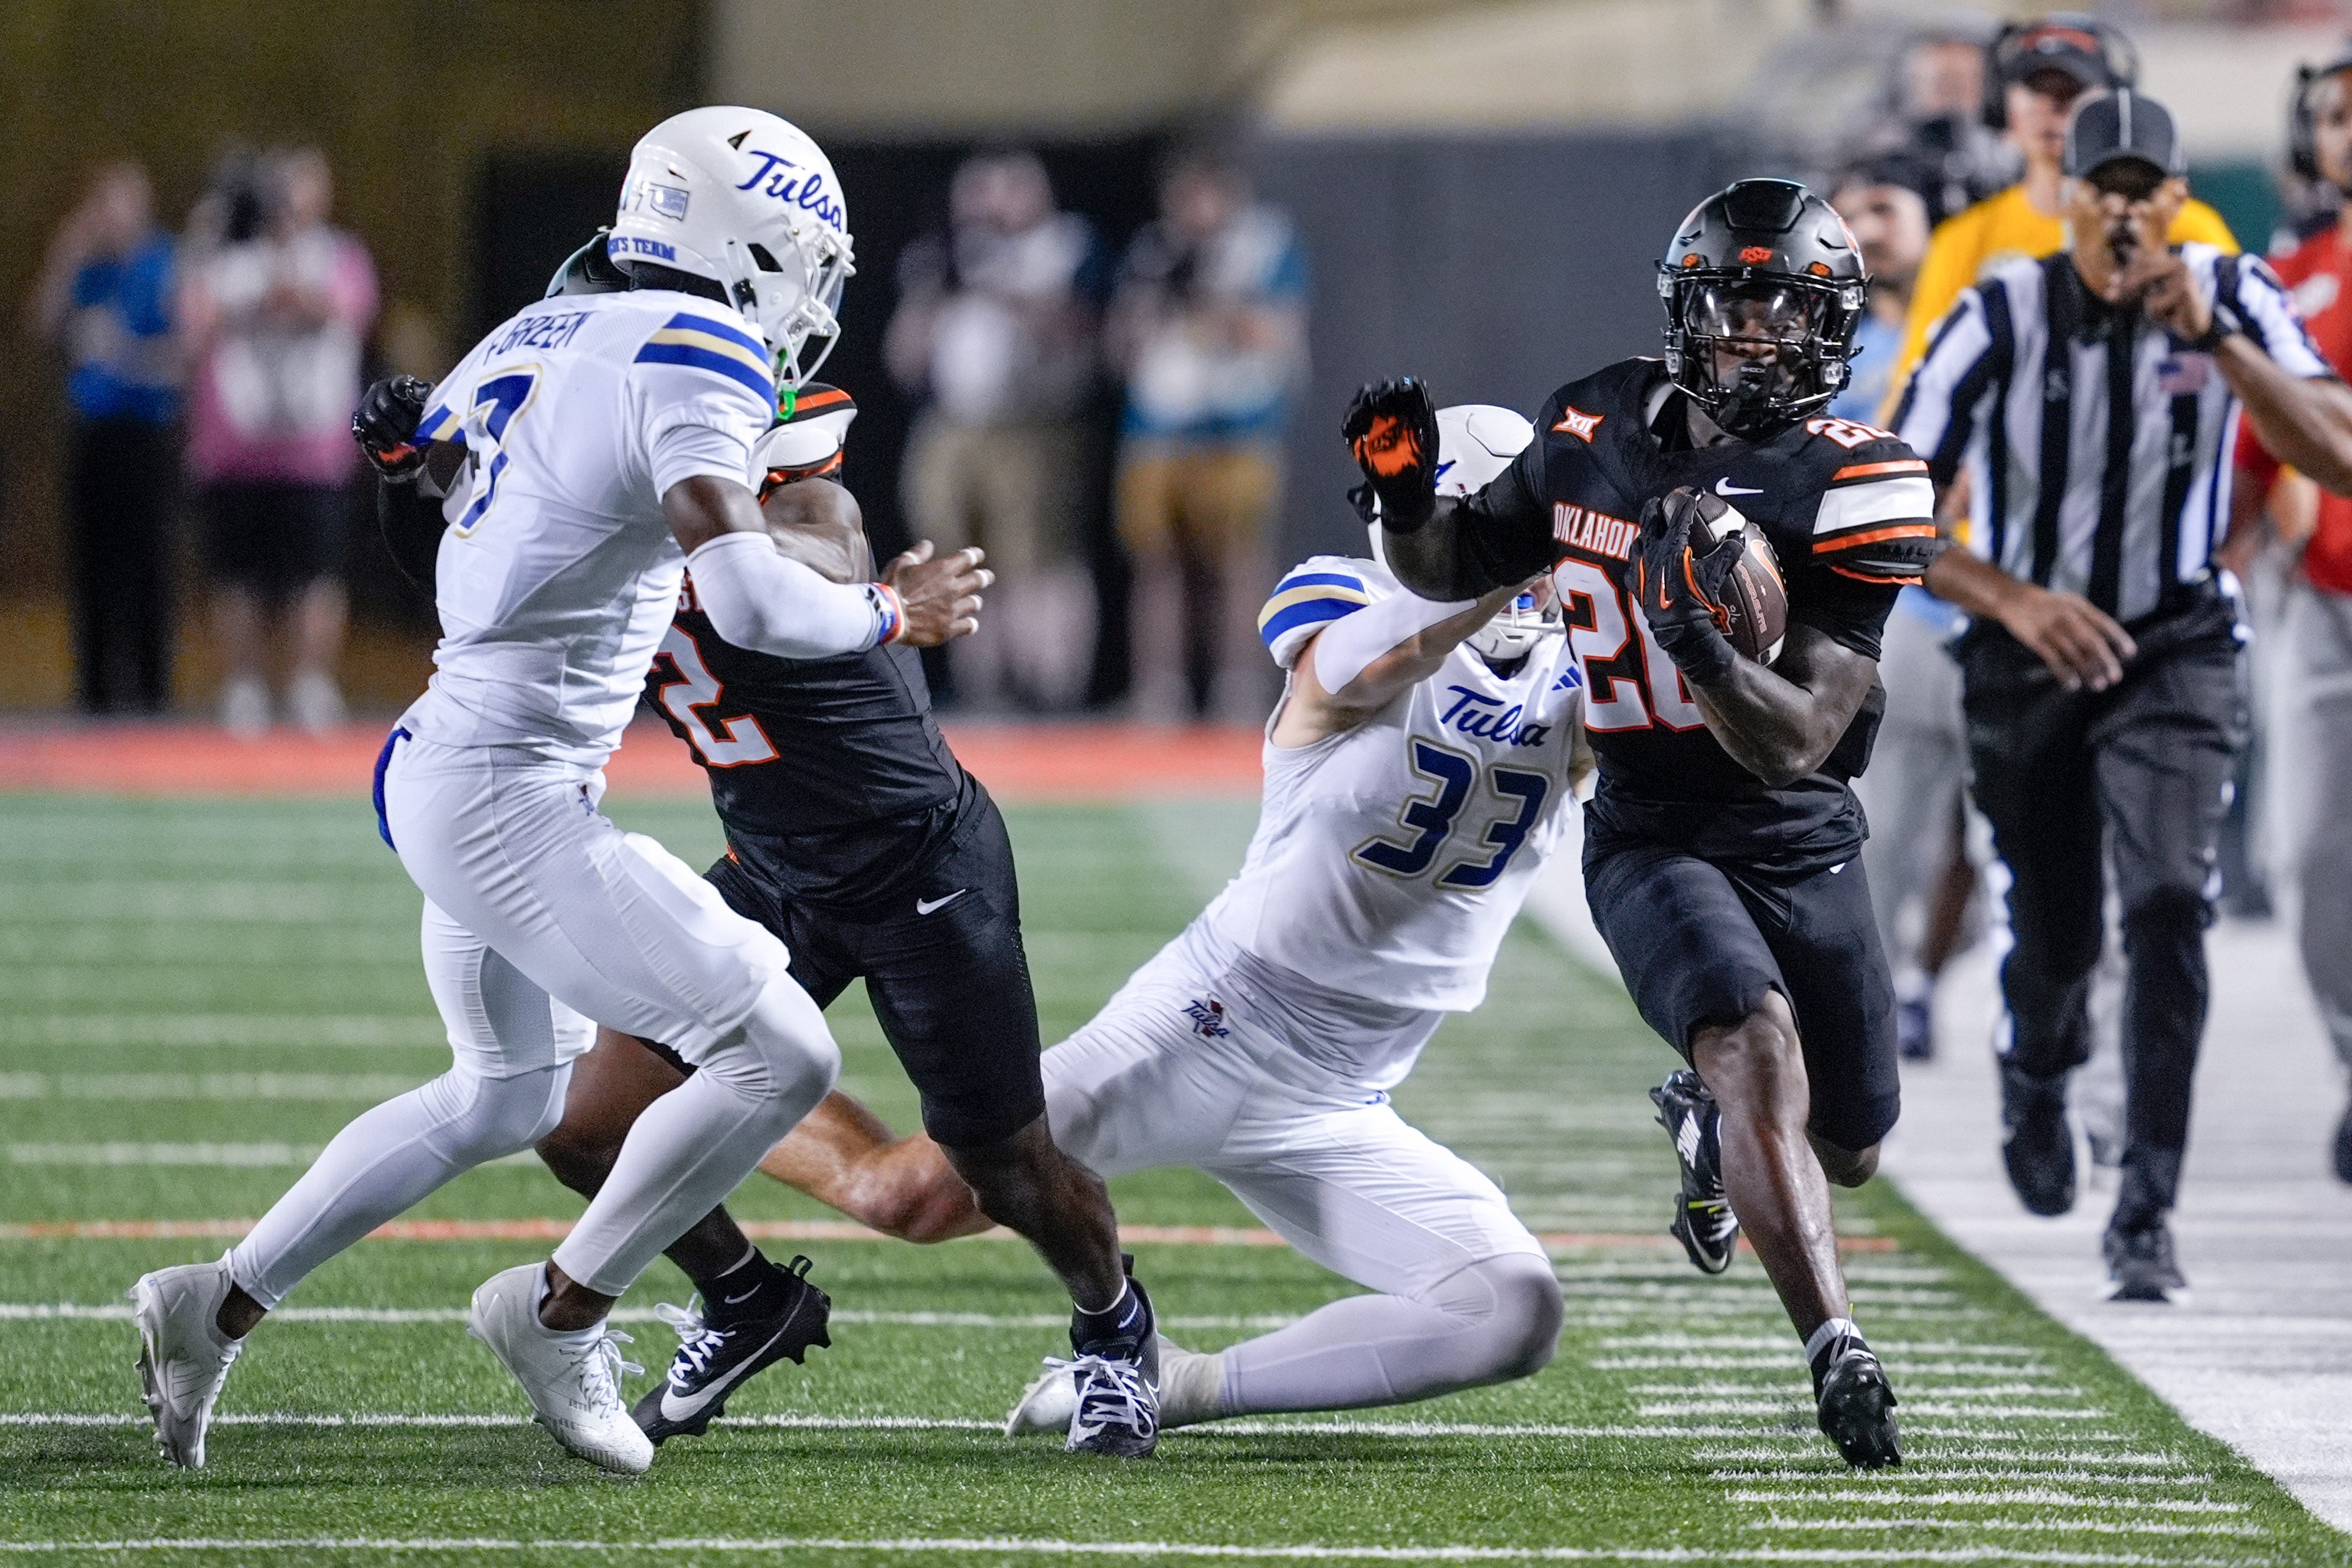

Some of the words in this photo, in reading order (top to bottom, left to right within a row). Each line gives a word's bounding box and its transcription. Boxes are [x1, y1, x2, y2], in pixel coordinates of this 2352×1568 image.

[737, 151, 842, 232] Tulsa
[632, 237, 676, 262] TEAM
[455, 362, 543, 538] 7
[1440, 685, 1551, 747] Tulsa
[1350, 734, 1553, 893] 33
